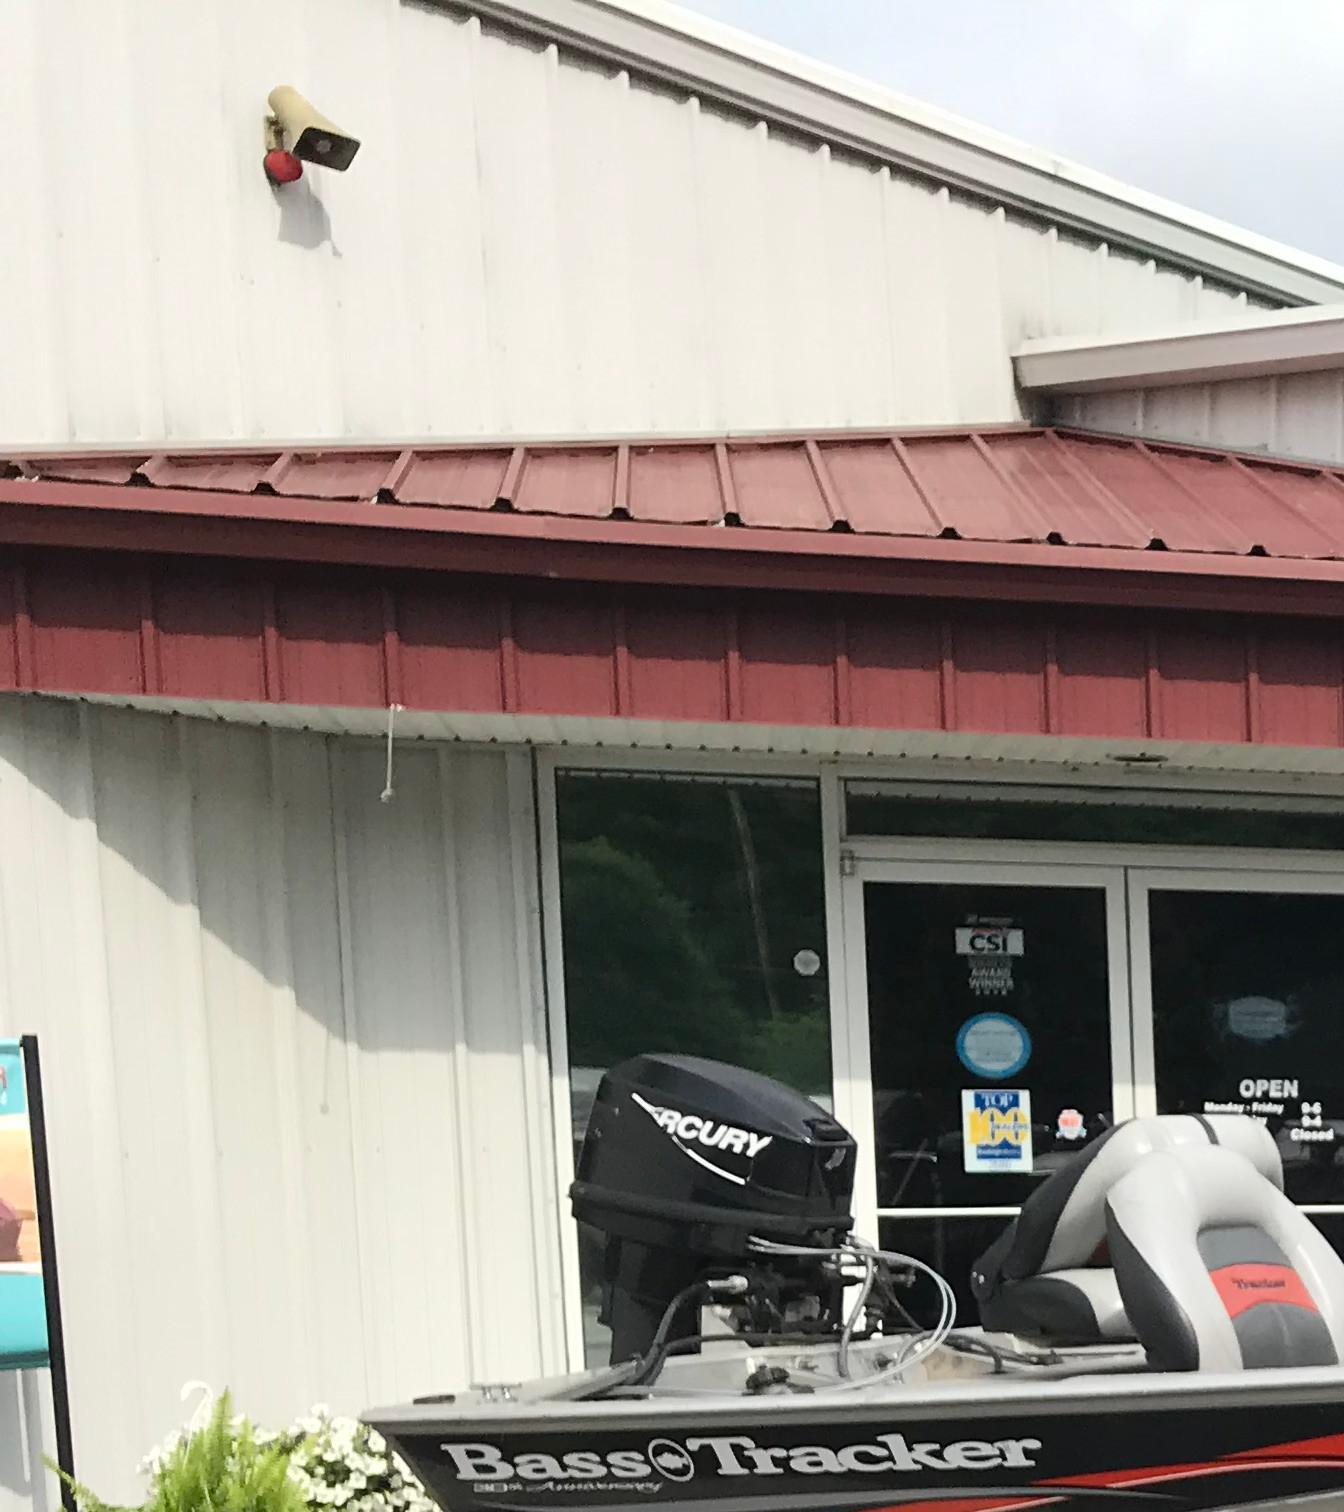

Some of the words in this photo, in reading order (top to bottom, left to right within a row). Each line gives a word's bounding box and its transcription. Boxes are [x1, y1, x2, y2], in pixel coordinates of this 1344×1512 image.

[969, 934, 1008, 952] CSI
[1239, 1078, 1299, 1099] OPEN
[981, 1091, 1014, 1107] TOP
[1203, 1101, 1245, 1113] Monday
[1251, 1101, 1284, 1115] Friday
[967, 1106, 1027, 1146] 100
[1289, 1127, 1335, 1141] Closed
[440, 1442, 652, 1481] Bass
[686, 1433, 1042, 1477] Tracker
